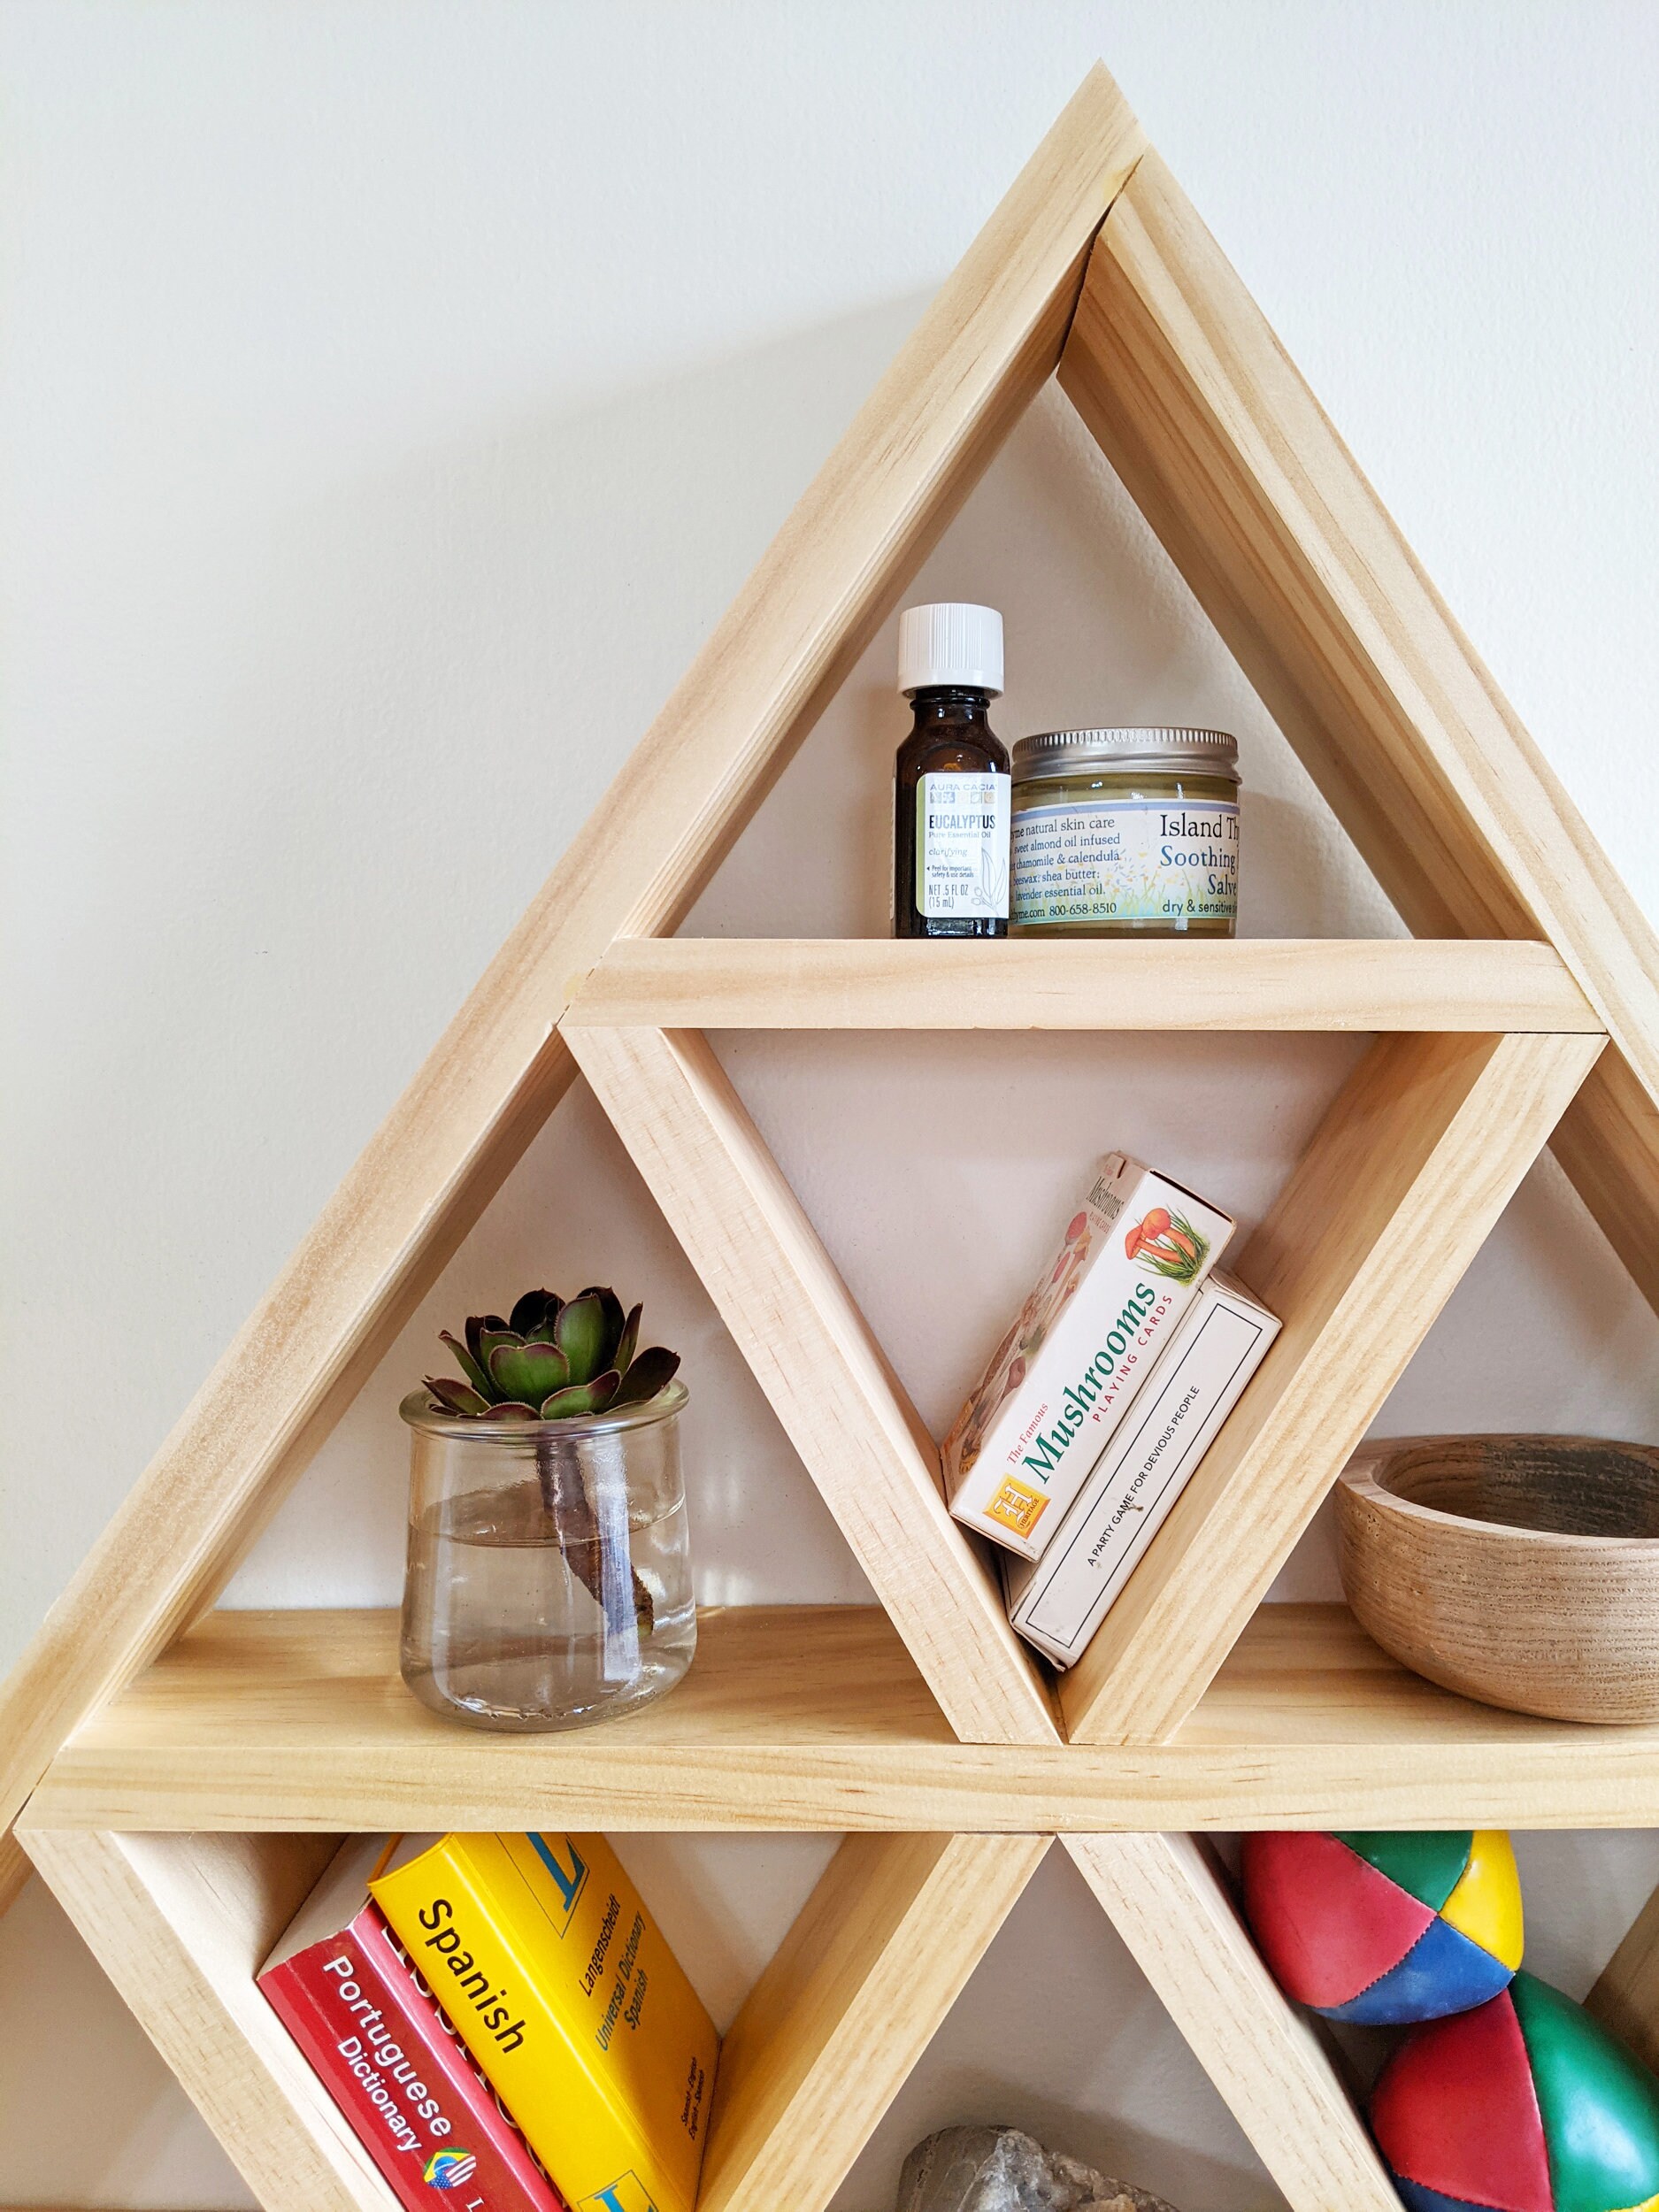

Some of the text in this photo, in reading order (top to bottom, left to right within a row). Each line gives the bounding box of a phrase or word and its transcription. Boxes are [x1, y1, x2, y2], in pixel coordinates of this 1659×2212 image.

[929, 815, 995, 829] EUCALYPTUS
[1026, 819, 1057, 836] natural
[1061, 818, 1085, 831] skin
[1089, 818, 1115, 828] care
[1160, 812, 1222, 838] Island
[929, 848, 968, 857] clarifying
[1014, 833, 1120, 854] sweet almond oil infused
[1017, 855, 1054, 870] chamomile
[1057, 854, 1065, 864] &
[1069, 849, 1120, 864] calendula
[1160, 845, 1235, 875] Soothing
[1042, 870, 1062, 882] shea
[1066, 869, 1100, 880] butter:
[1208, 874, 1236, 896] Salve
[929, 885, 968, 895] NET .5 FL OZ
[929, 896, 954, 909] (15 mL)
[1016, 888, 1041, 902] lavender
[1044, 885, 1086, 898] essential
[1089, 883, 1105, 895] oil.
[1049, 902, 1117, 916] 800-658-8510
[1163, 899, 1183, 916] dry
[1187, 899, 1195, 912] &
[1199, 901, 1232, 913] sensitive
[1086, 1176, 1125, 1220] Mushrooms
[1092, 1295, 1172, 1422] PLAYING CARDS
[1021, 1283, 1156, 1485] Mushrooms
[1007, 1402, 1048, 1465] The Famous
[1087, 1386, 1200, 1567] A PARTY GAME FOR DEVIOUS PEOPLE
[1019, 1498, 1040, 1528] HERITAGE
[579, 1893, 621, 1998] Langenscheidt
[419, 1899, 526, 2054] Spanish
[595, 1910, 647, 2052] Universal Dictionary
[624, 1968, 649, 2031] Spanish
[323, 1955, 451, 2137] Portuguese
[337, 2036, 422, 2152] Dictionary
